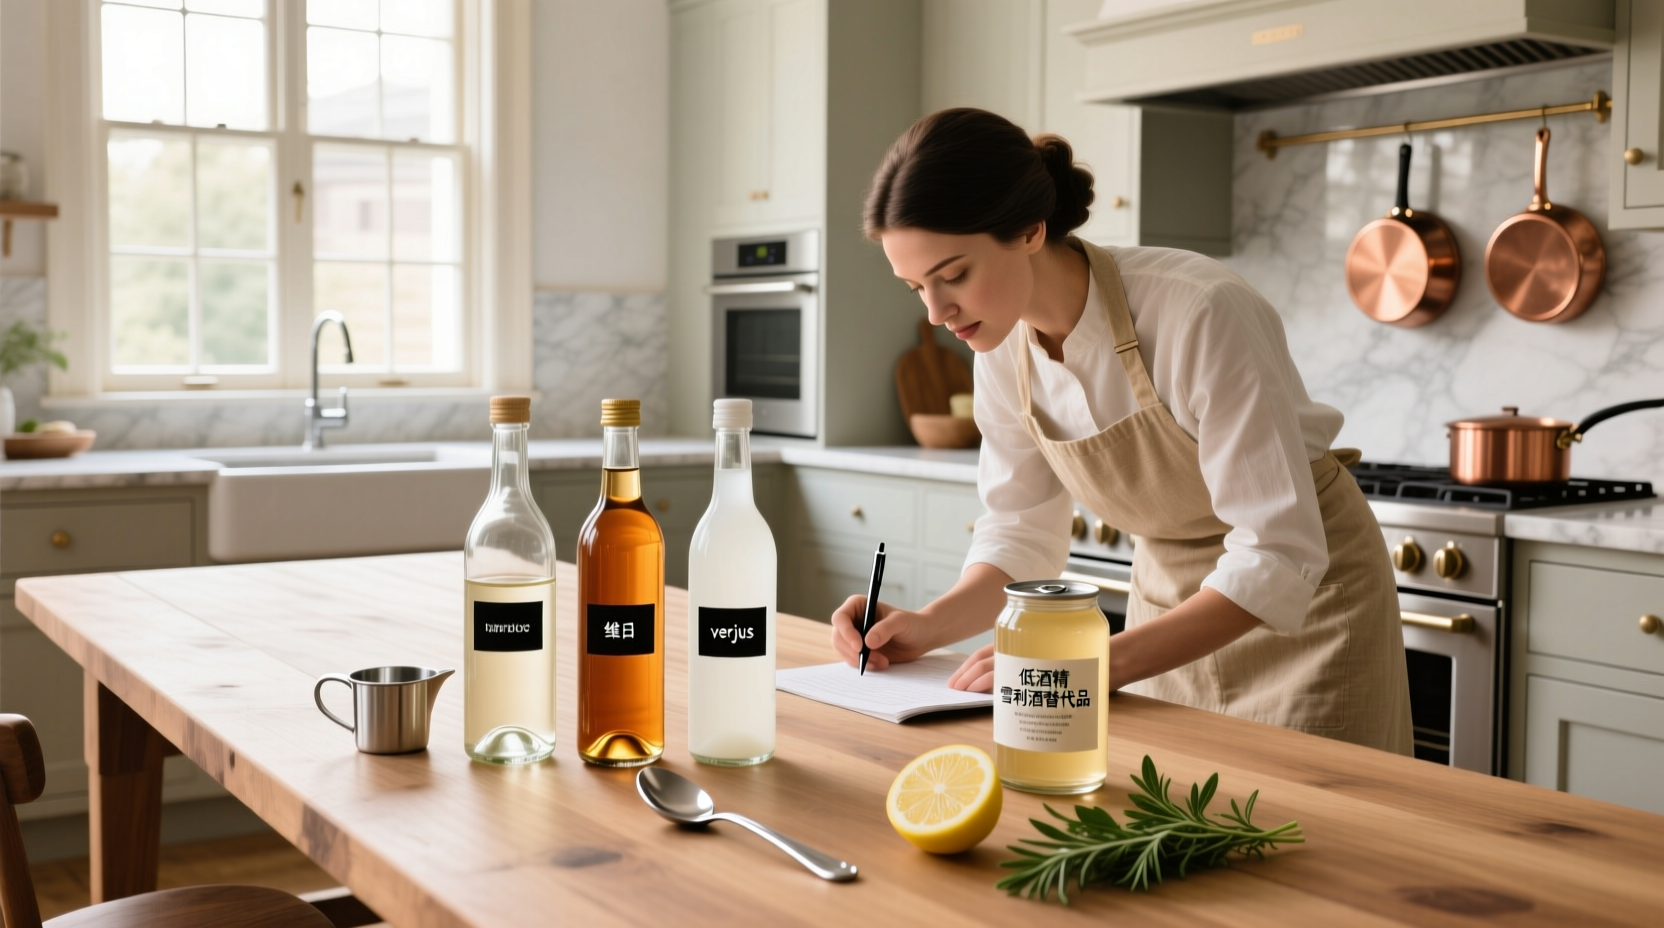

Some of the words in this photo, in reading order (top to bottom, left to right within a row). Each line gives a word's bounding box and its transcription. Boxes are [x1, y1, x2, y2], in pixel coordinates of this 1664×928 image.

[710, 624, 754, 644] verjus
[1019, 668, 1070, 688] 低酒精
[1000, 686, 1090, 708] 雪利酒替代品
